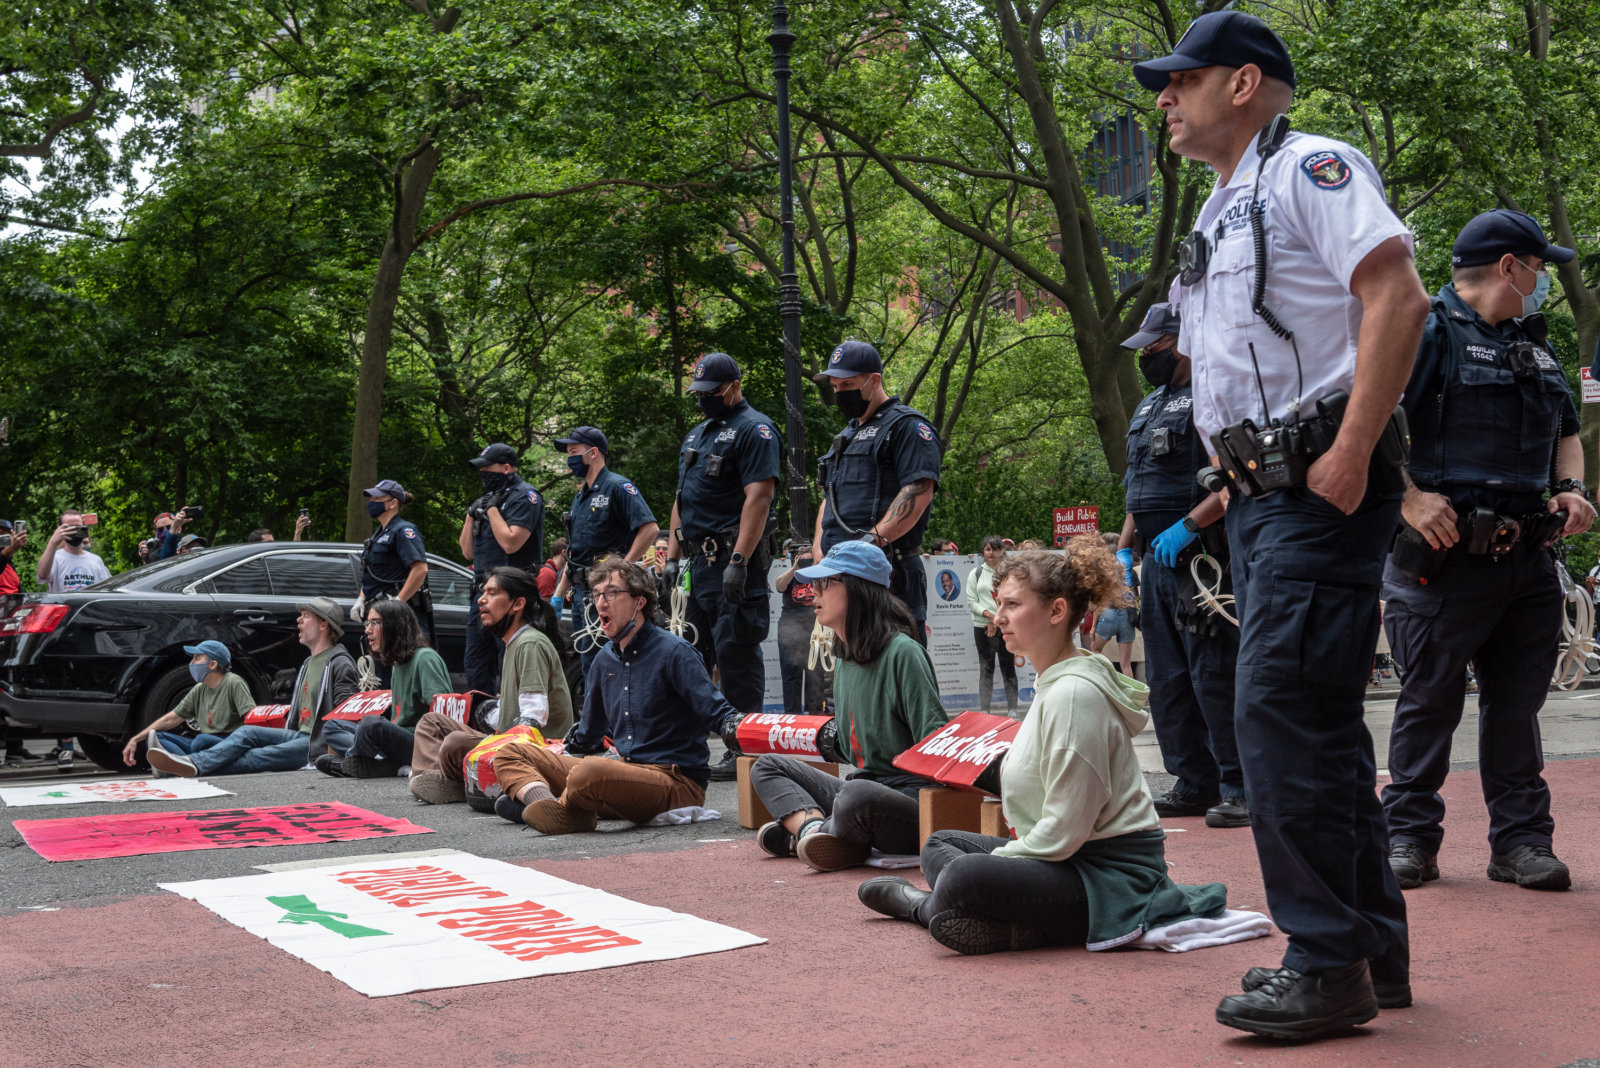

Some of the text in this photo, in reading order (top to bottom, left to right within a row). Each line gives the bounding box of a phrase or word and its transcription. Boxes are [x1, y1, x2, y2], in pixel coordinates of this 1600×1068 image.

[1466, 345, 1497, 356] AGUILAR
[1056, 508, 1097, 522] Build Public
[1057, 522, 1096, 534] RENEWABLES
[768, 724, 817, 753] POWER
[916, 723, 976, 758] PUBLIC
